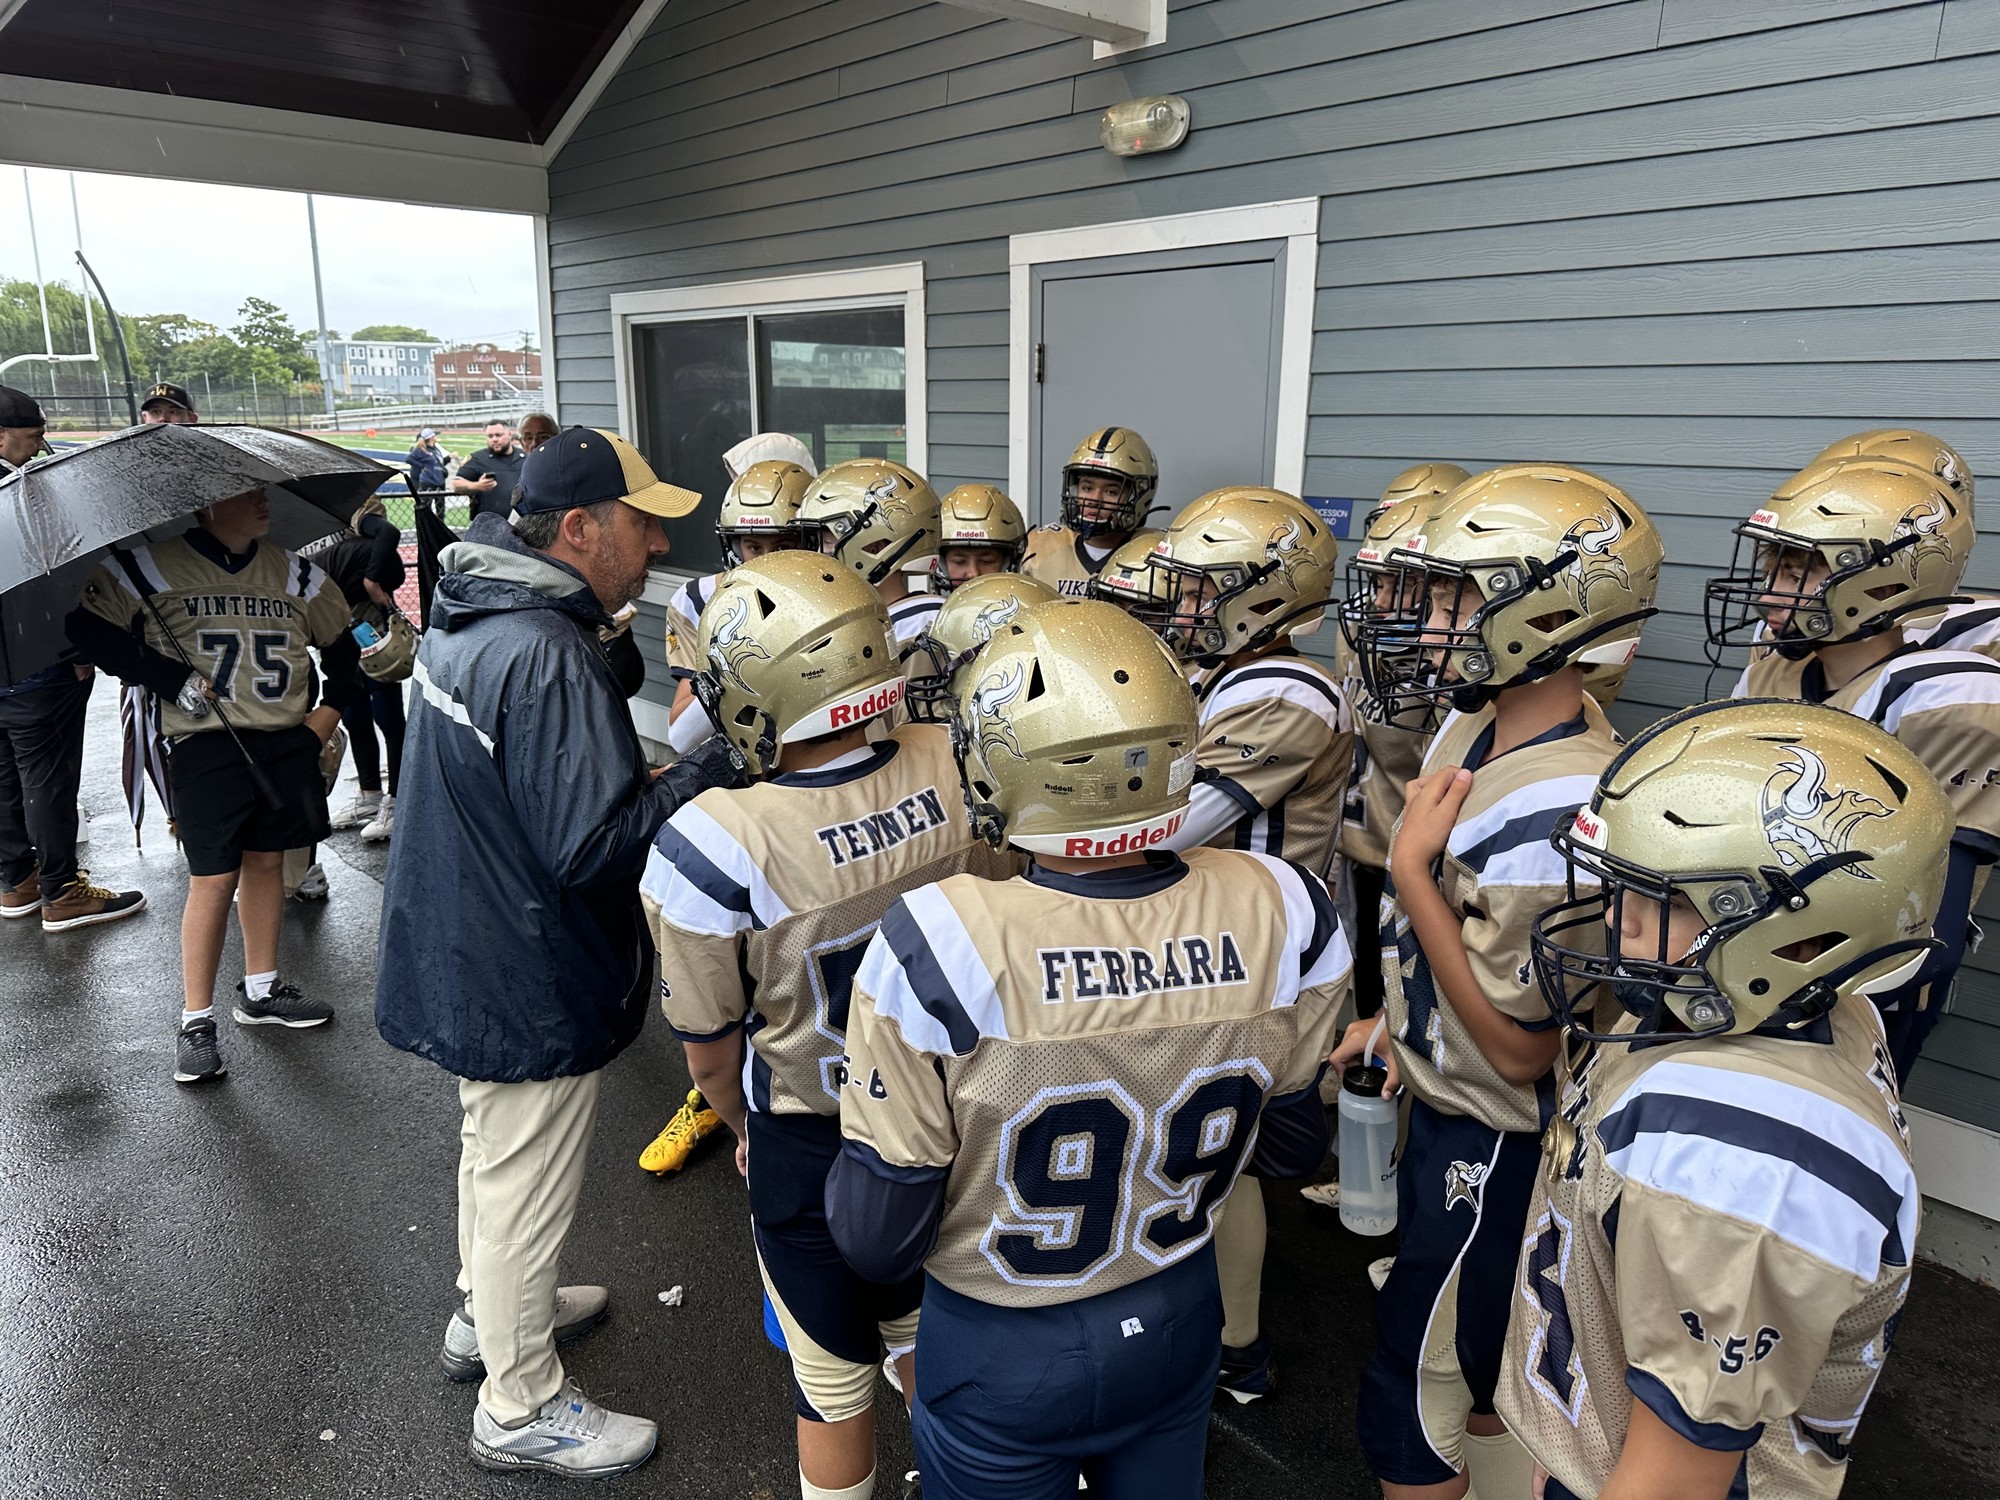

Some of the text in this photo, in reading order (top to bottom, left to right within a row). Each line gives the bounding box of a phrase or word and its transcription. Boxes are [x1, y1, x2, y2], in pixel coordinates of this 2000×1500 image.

[155, 385, 168, 396] W
[739, 516, 771, 526] Riddell
[1107, 576, 1136, 589] Riddell
[196, 628, 293, 704] 75
[829, 680, 905, 729] Riddell
[1044, 783, 1073, 793] Riddell
[814, 785, 949, 868] TENNEN
[1065, 813, 1182, 858] Riddell
[1037, 931, 1249, 1004] FERRARA
[979, 1056, 1274, 1287] 99
[1679, 1309, 1782, 1376] 4-5-6
